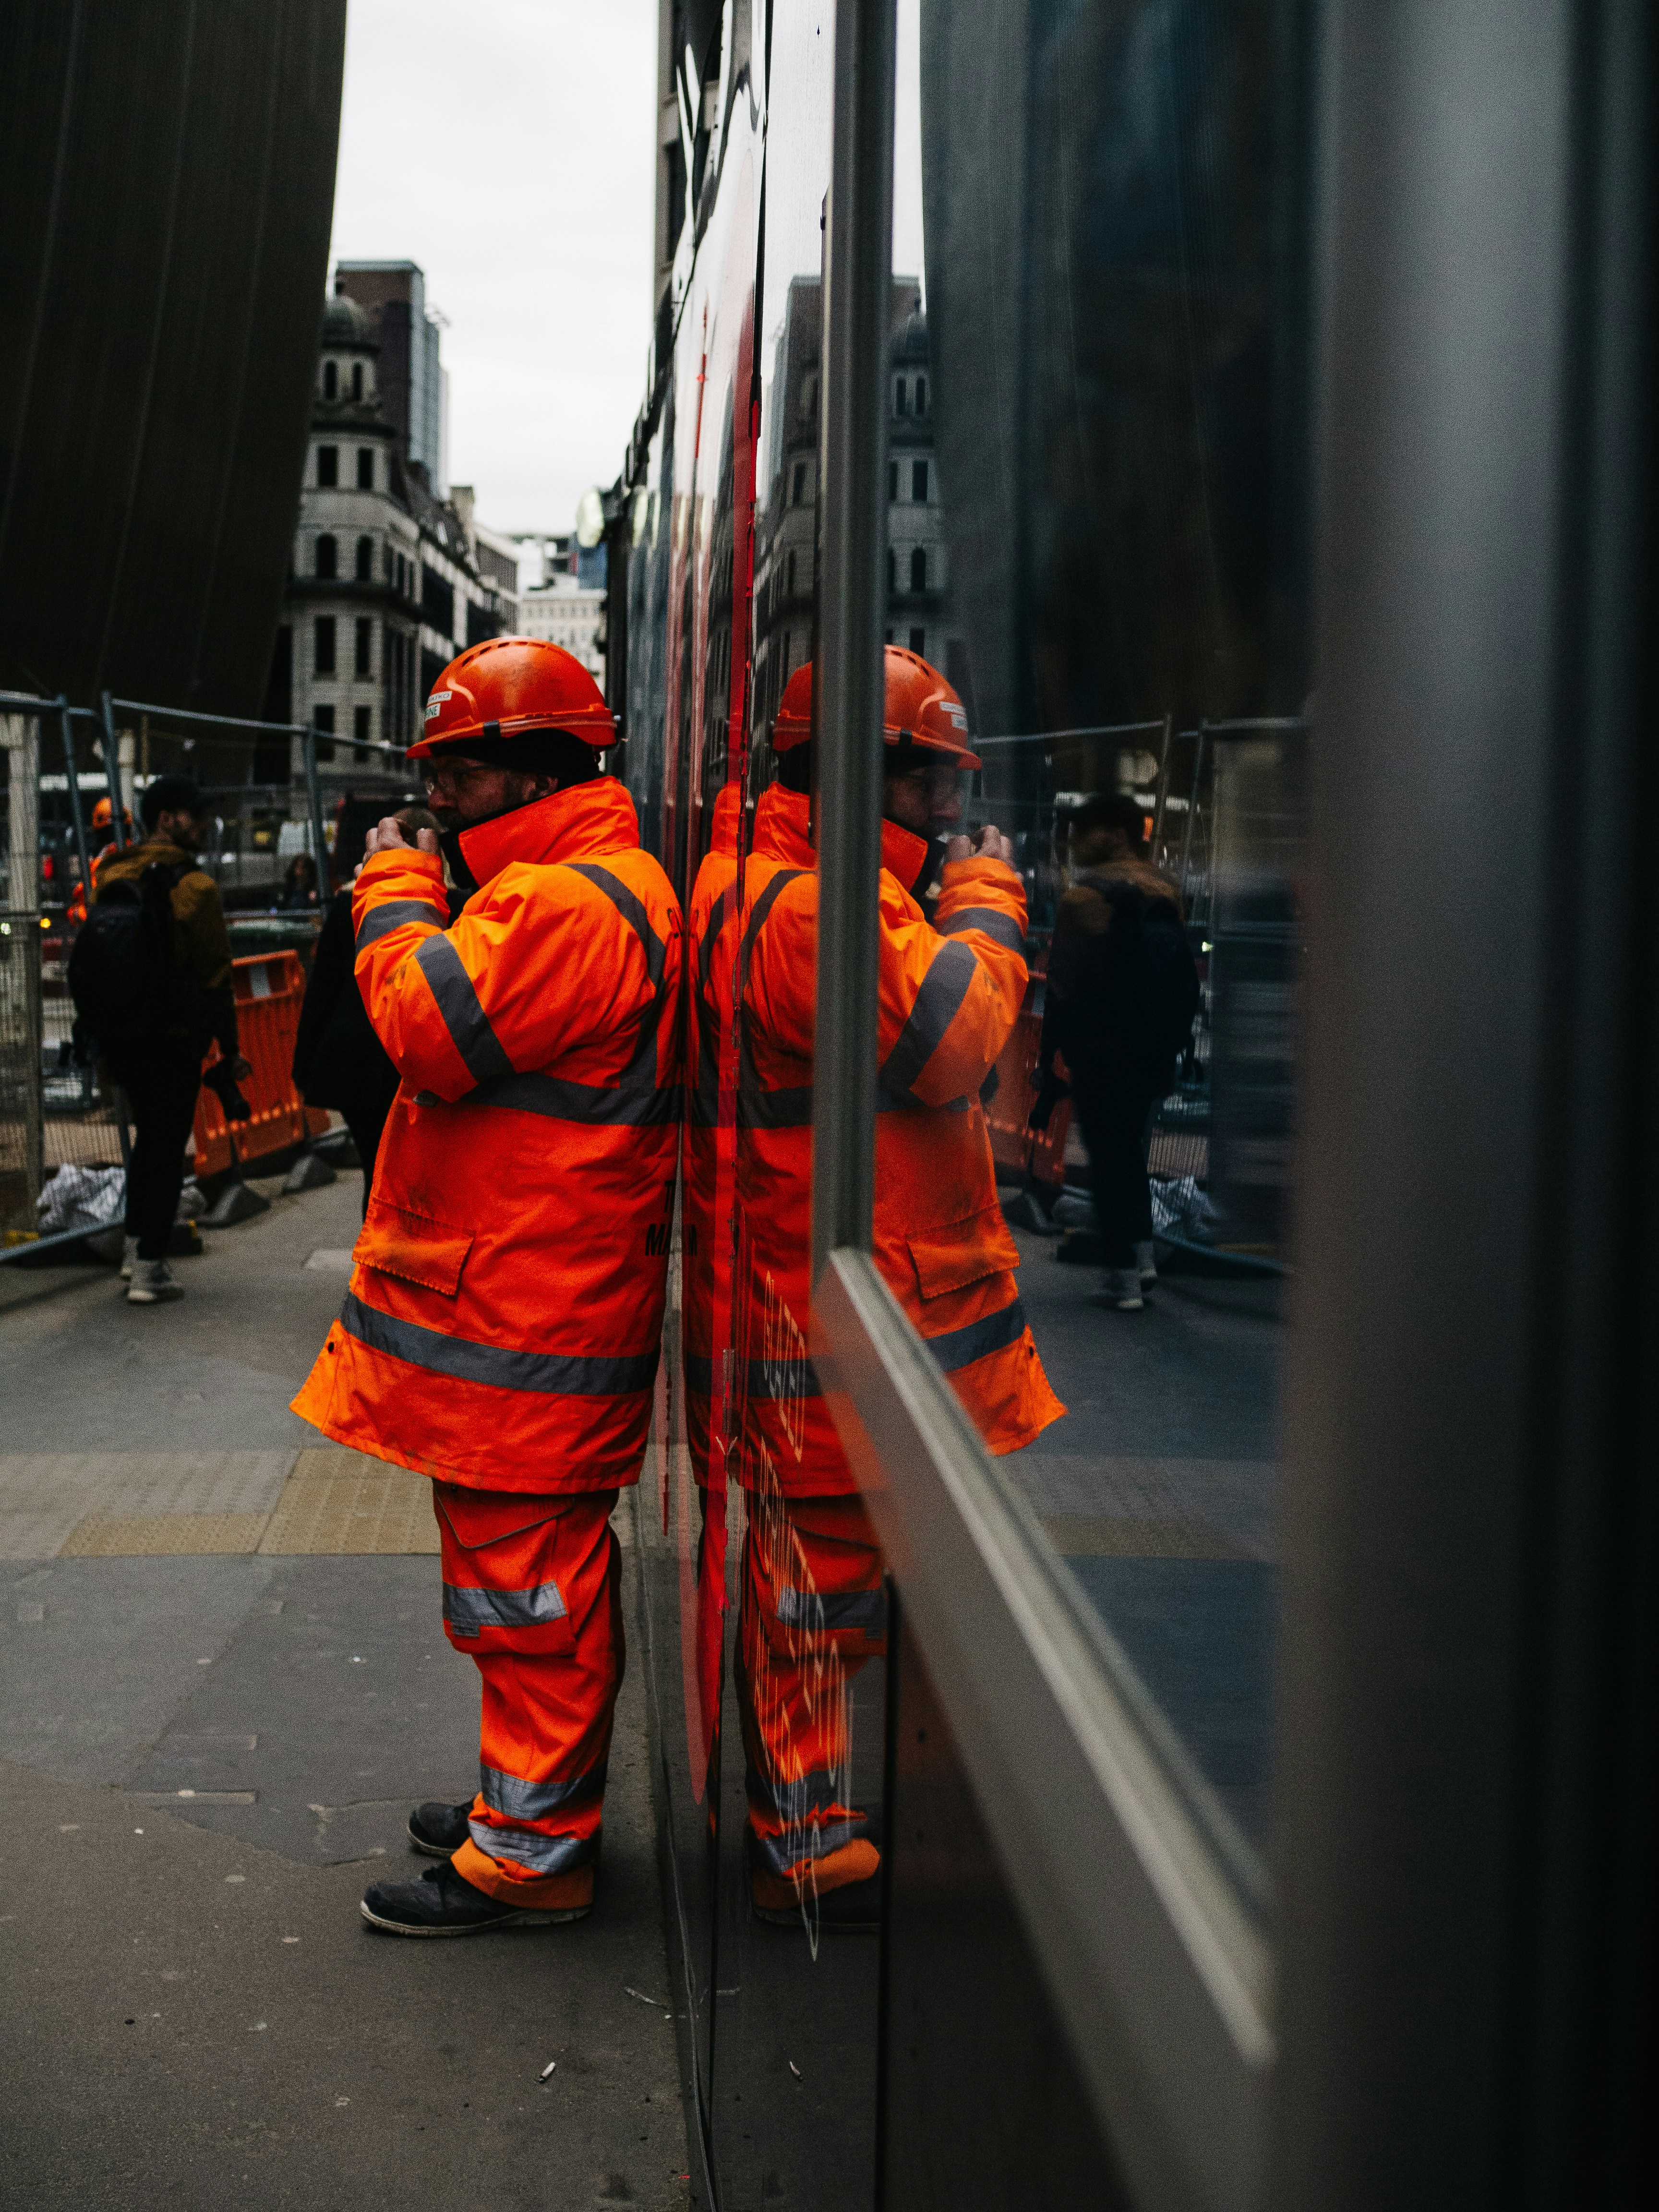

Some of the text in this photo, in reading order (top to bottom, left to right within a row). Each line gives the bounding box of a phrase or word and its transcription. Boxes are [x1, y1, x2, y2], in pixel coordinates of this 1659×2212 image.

[764, 1270, 805, 1463] GLAZED
[754, 1610, 821, 1962] ALL LEVELS
[758, 1435, 854, 1841] PERIMETER ON
